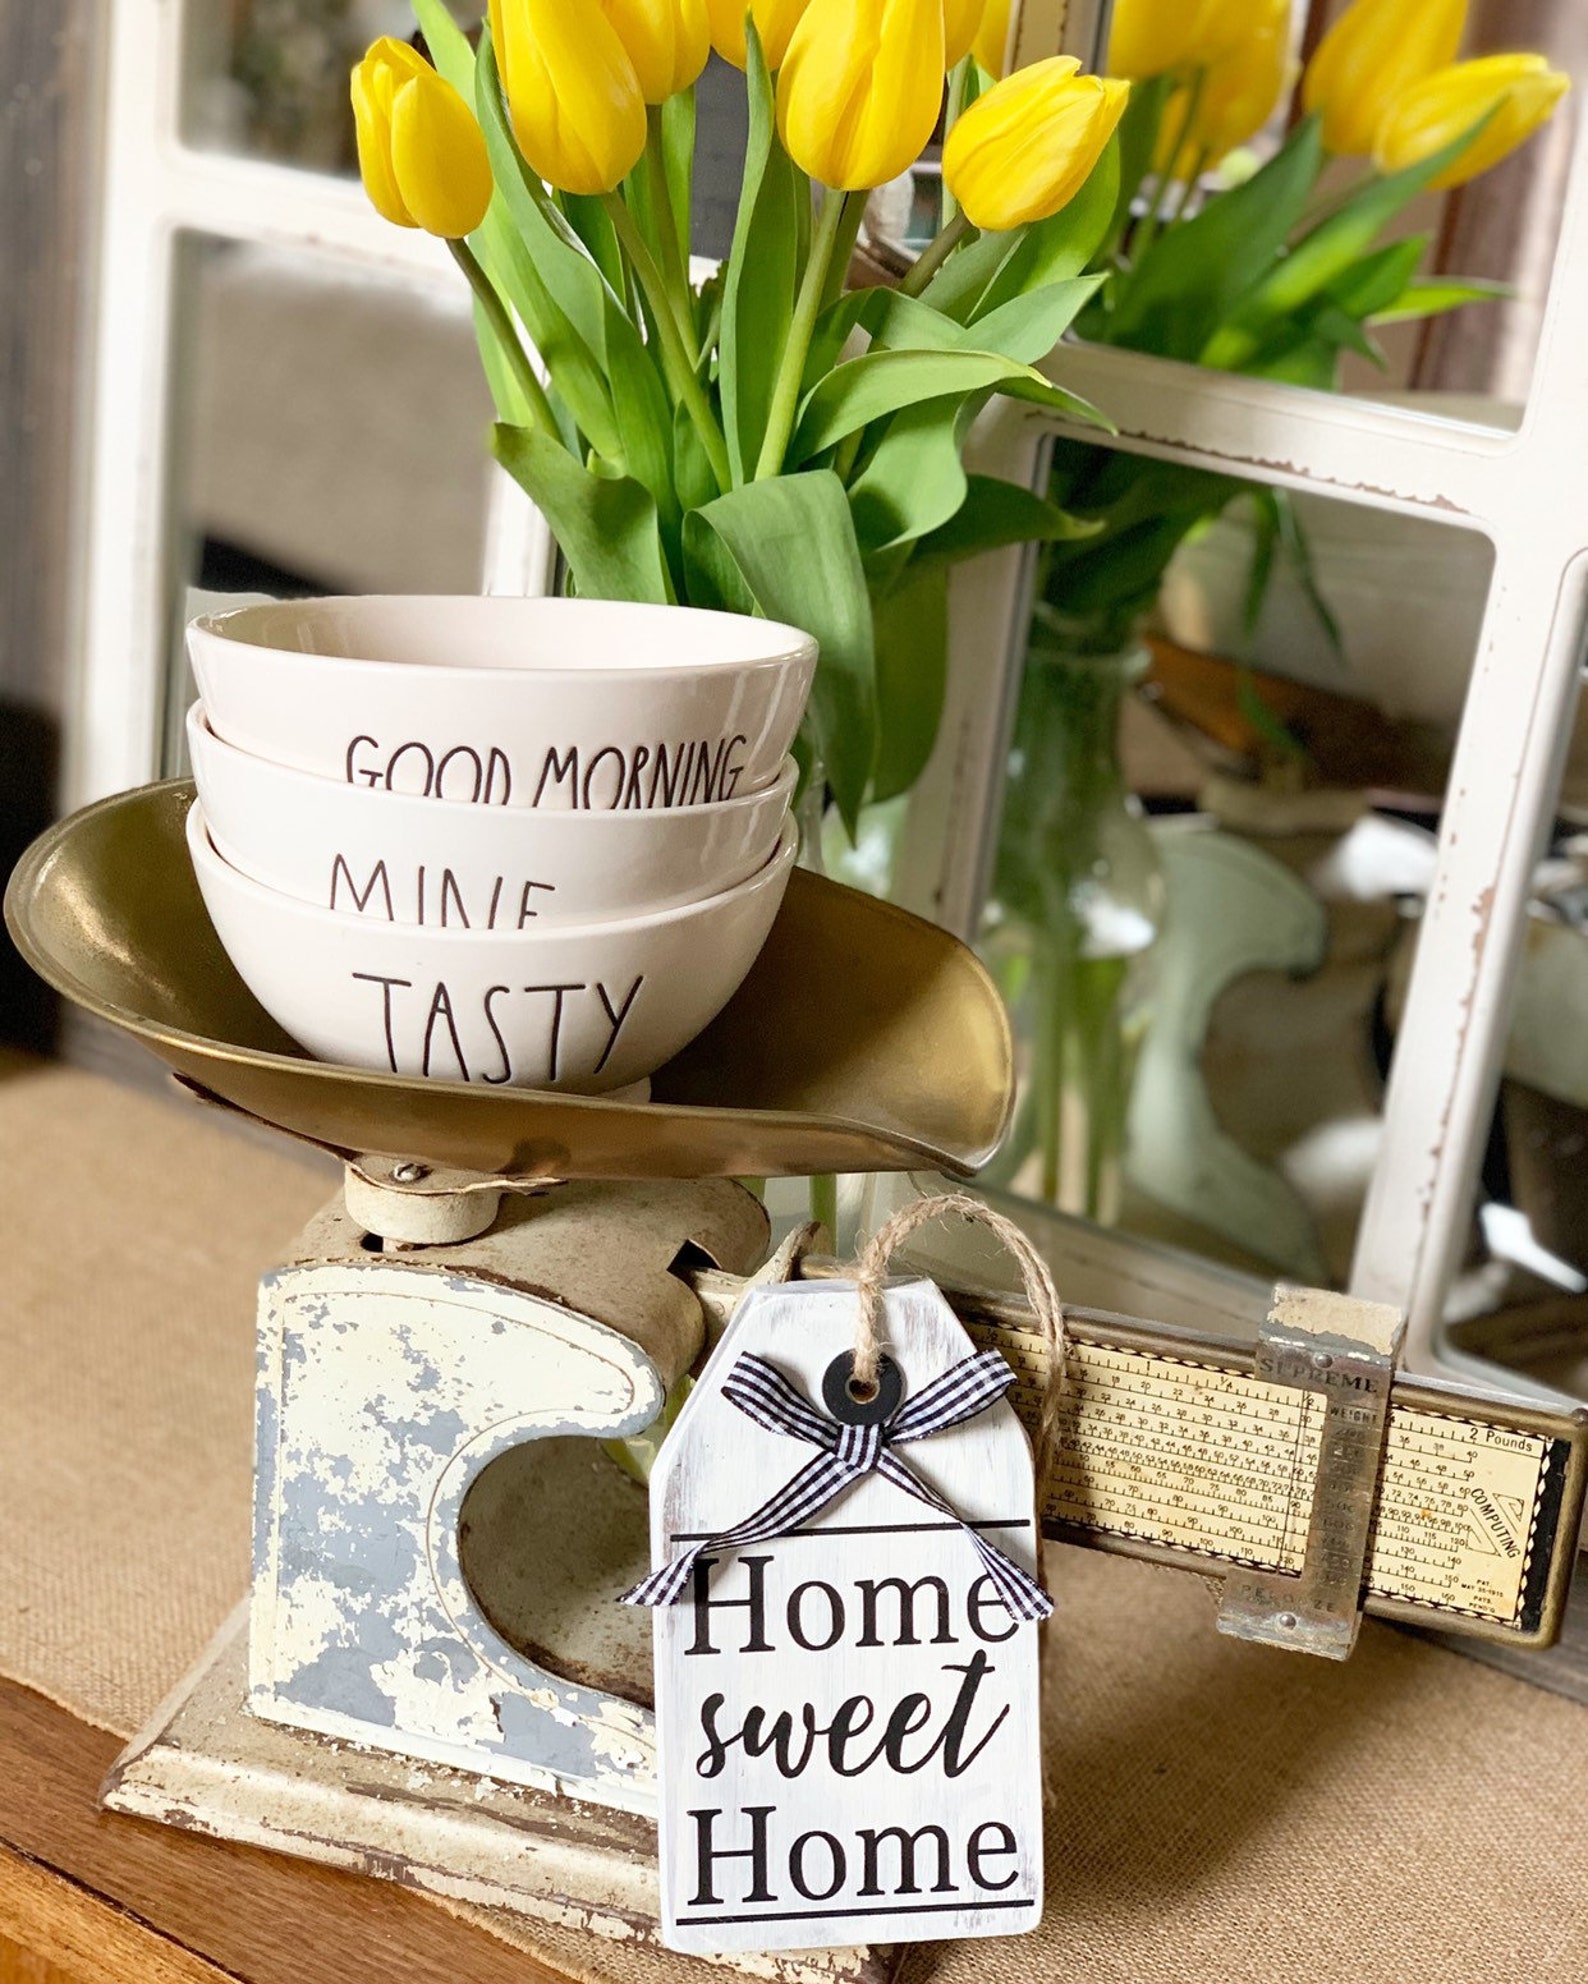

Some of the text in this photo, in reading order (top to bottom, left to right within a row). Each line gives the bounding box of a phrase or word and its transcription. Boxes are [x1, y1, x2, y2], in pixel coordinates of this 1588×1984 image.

[347, 734, 746, 810] GOOD MORNING
[352, 971, 643, 1084] TASTY
[1330, 1407, 1377, 1425] WEIGHT
[1469, 1427, 1478, 1440] 2
[1486, 1430, 1532, 1452] Pounds
[1471, 1488, 1520, 1558] COMPUTING
[685, 1555, 1019, 1655] Home
[696, 1648, 1011, 1779] sweet
[687, 1805, 1020, 1906] Home
